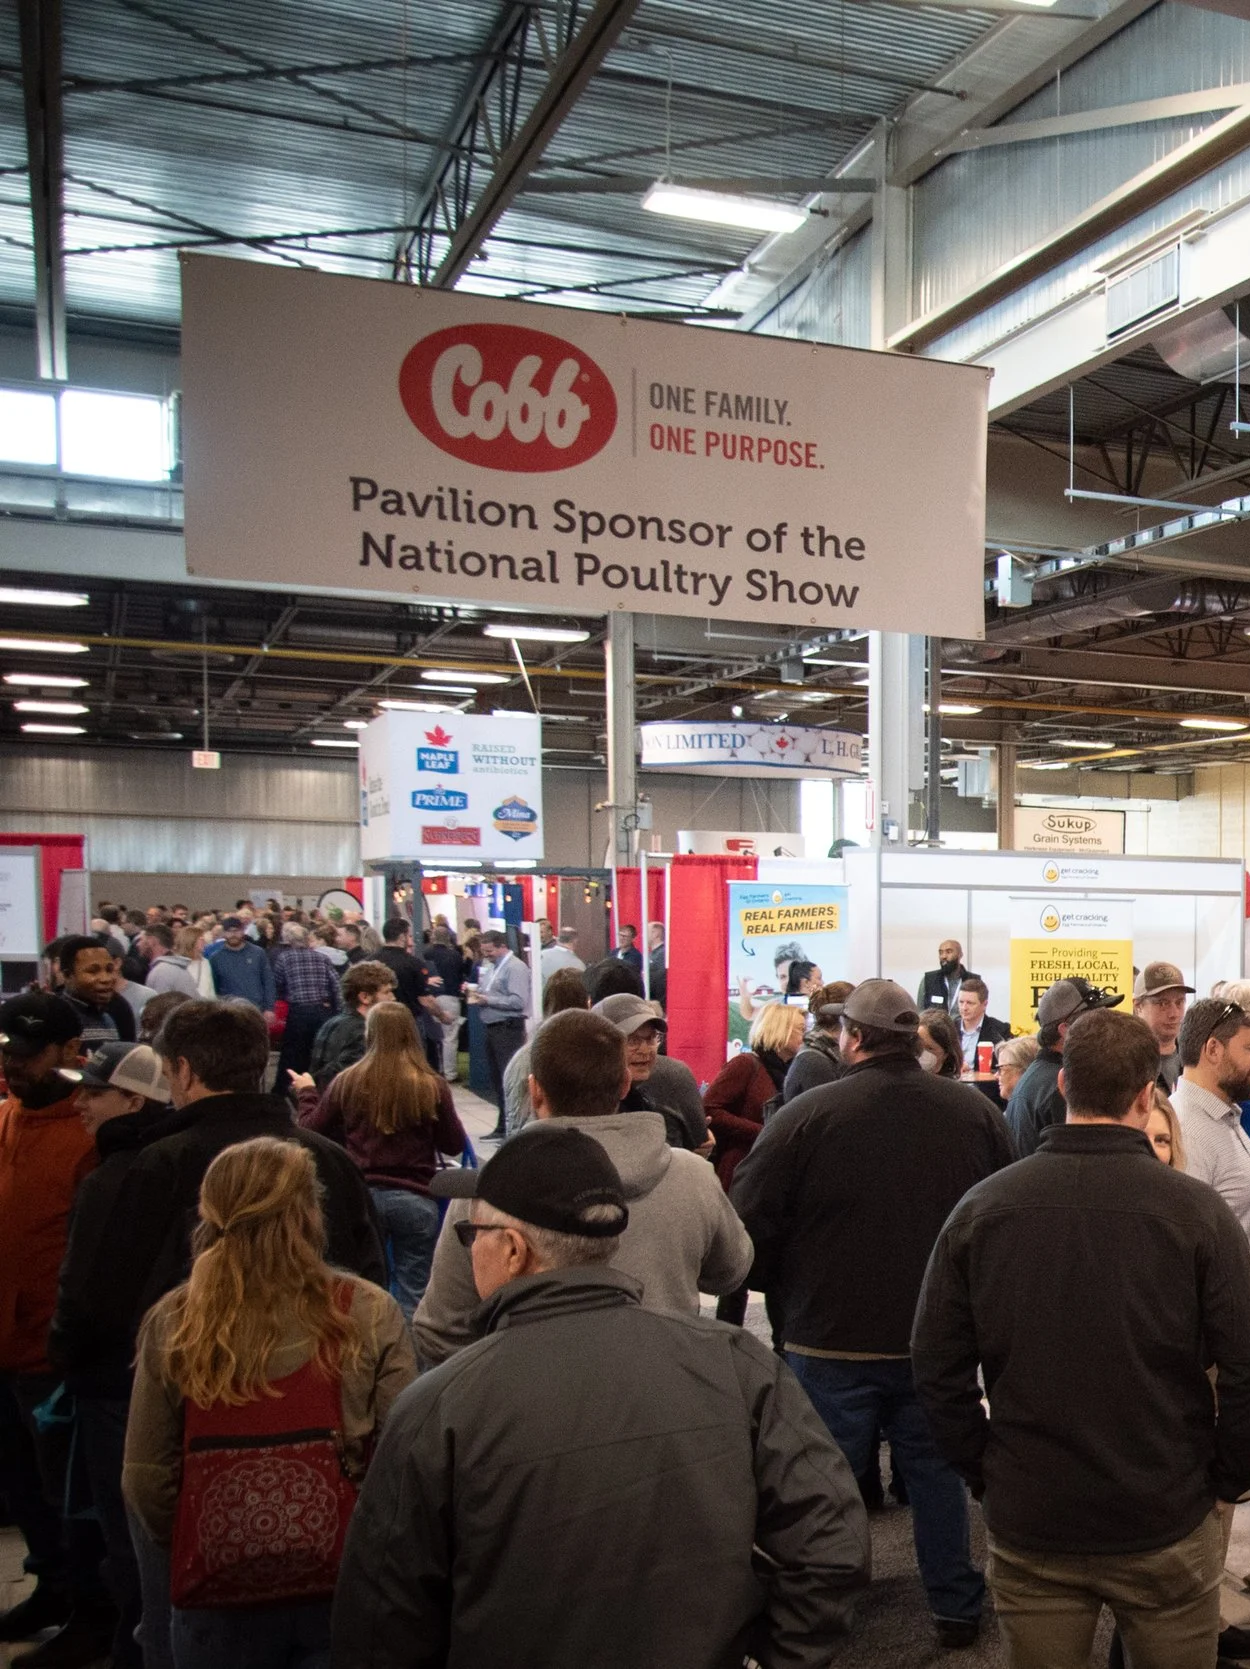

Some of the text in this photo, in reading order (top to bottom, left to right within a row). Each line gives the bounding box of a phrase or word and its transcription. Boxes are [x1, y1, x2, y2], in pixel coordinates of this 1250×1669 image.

[431, 343, 591, 449] Cobb
[650, 382, 792, 426] ONE FAMILY.
[650, 423, 825, 470] ONE PURPOSE.
[349, 476, 866, 561] Pavilion Sponsor of the
[359, 531, 860, 608] National Poultry Show
[666, 733, 746, 749] LIMITED
[472, 744, 516, 753] RAISED
[420, 752, 455, 762] MAPLE
[473, 755, 537, 766] WITHOUT
[425, 760, 451, 769] LEAF
[473, 766, 528, 775] antibiotics
[415, 794, 464, 807] PRIME
[1047, 815, 1091, 832] Sukup
[1033, 834, 1102, 846] Grain Systems
[744, 906, 837, 921] REAL FARMERS.
[1061, 913, 1074, 921] get
[746, 920, 837, 934] REAL FAMILIES.
[1051, 947, 1098, 959] Providing
[1030, 960, 1119, 971] FRESH, LOCAL,
